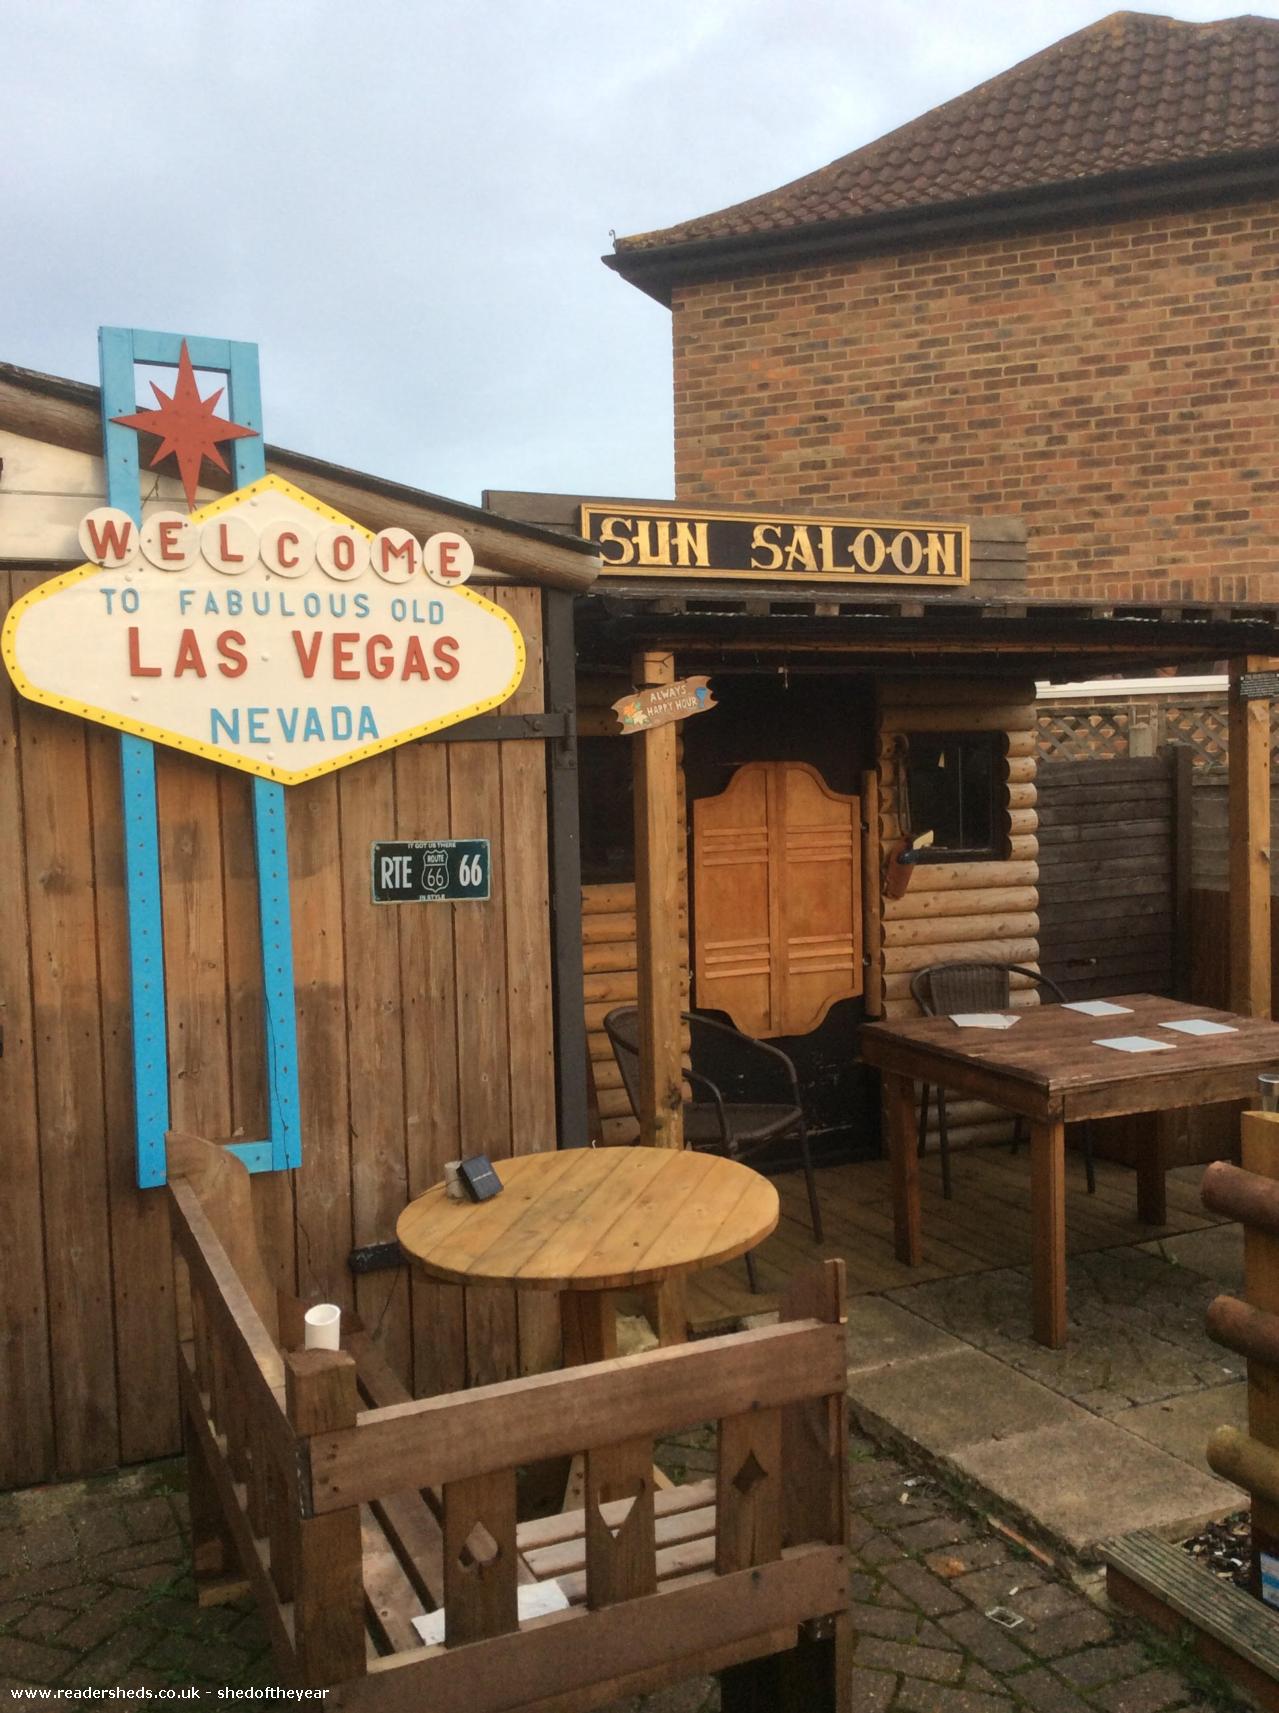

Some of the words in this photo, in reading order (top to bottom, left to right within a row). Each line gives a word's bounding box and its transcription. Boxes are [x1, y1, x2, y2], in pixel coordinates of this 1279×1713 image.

[85, 518, 462, 578] WELCOME
[600, 517, 711, 567] SUN
[751, 524, 956, 575] SALOON
[100, 587, 141, 615] TO
[179, 589, 372, 619] FABULOUS
[390, 598, 445, 625] OLD
[128, 626, 249, 679] LAS
[291, 629, 462, 682] VEGAS
[647, 702, 673, 717] HAPPY
[675, 696, 698, 711] HOUR
[650, 685, 687, 703] ALWAYS
[210, 705, 381, 745] NEVADA
[381, 856, 412, 889] RTE
[427, 855, 444, 863] ROUTE
[459, 855, 482, 887] 66
[427, 867, 444, 886] 66
